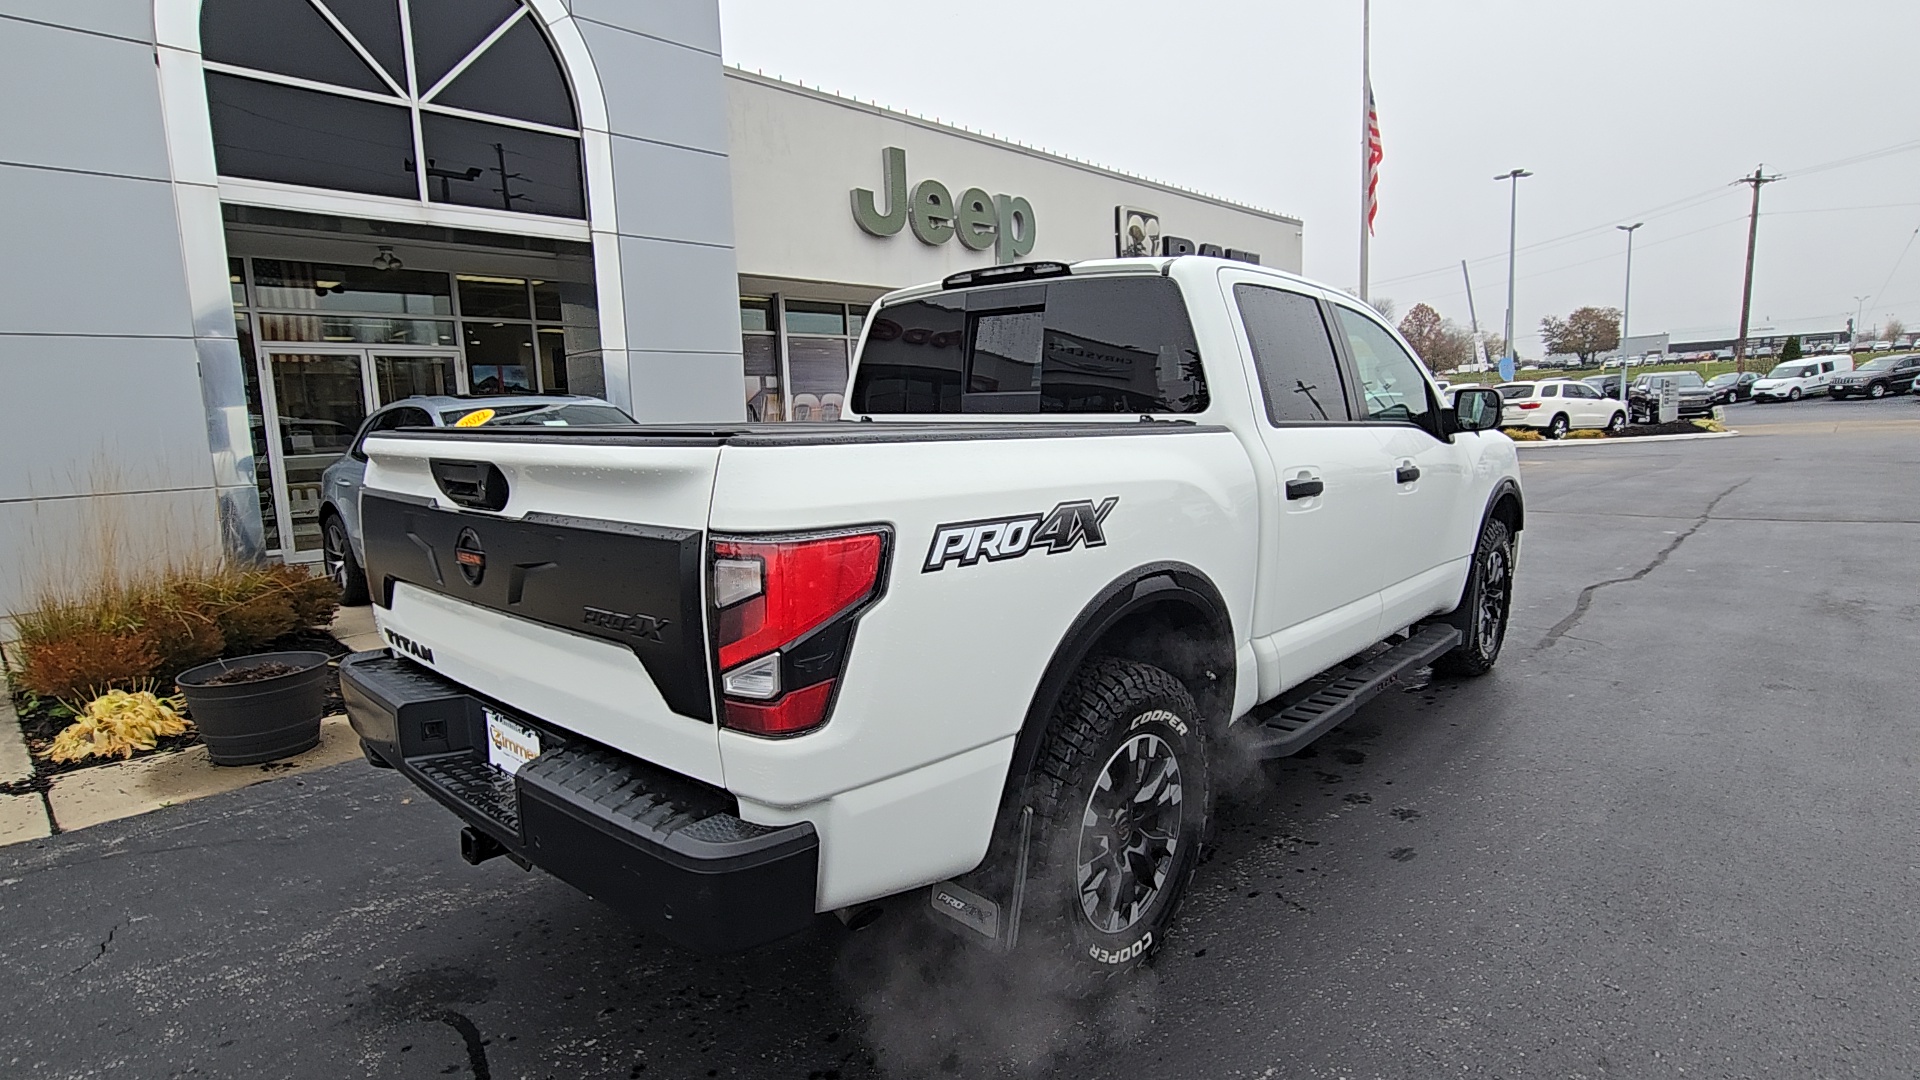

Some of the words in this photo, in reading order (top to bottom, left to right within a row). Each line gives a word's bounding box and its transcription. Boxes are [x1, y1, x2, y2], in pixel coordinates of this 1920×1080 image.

[850, 147, 1036, 264] Jeep
[384, 627, 435, 665] TITAN
[1130, 709, 1188, 737] COOPER
[1089, 931, 1153, 964] COOPER
